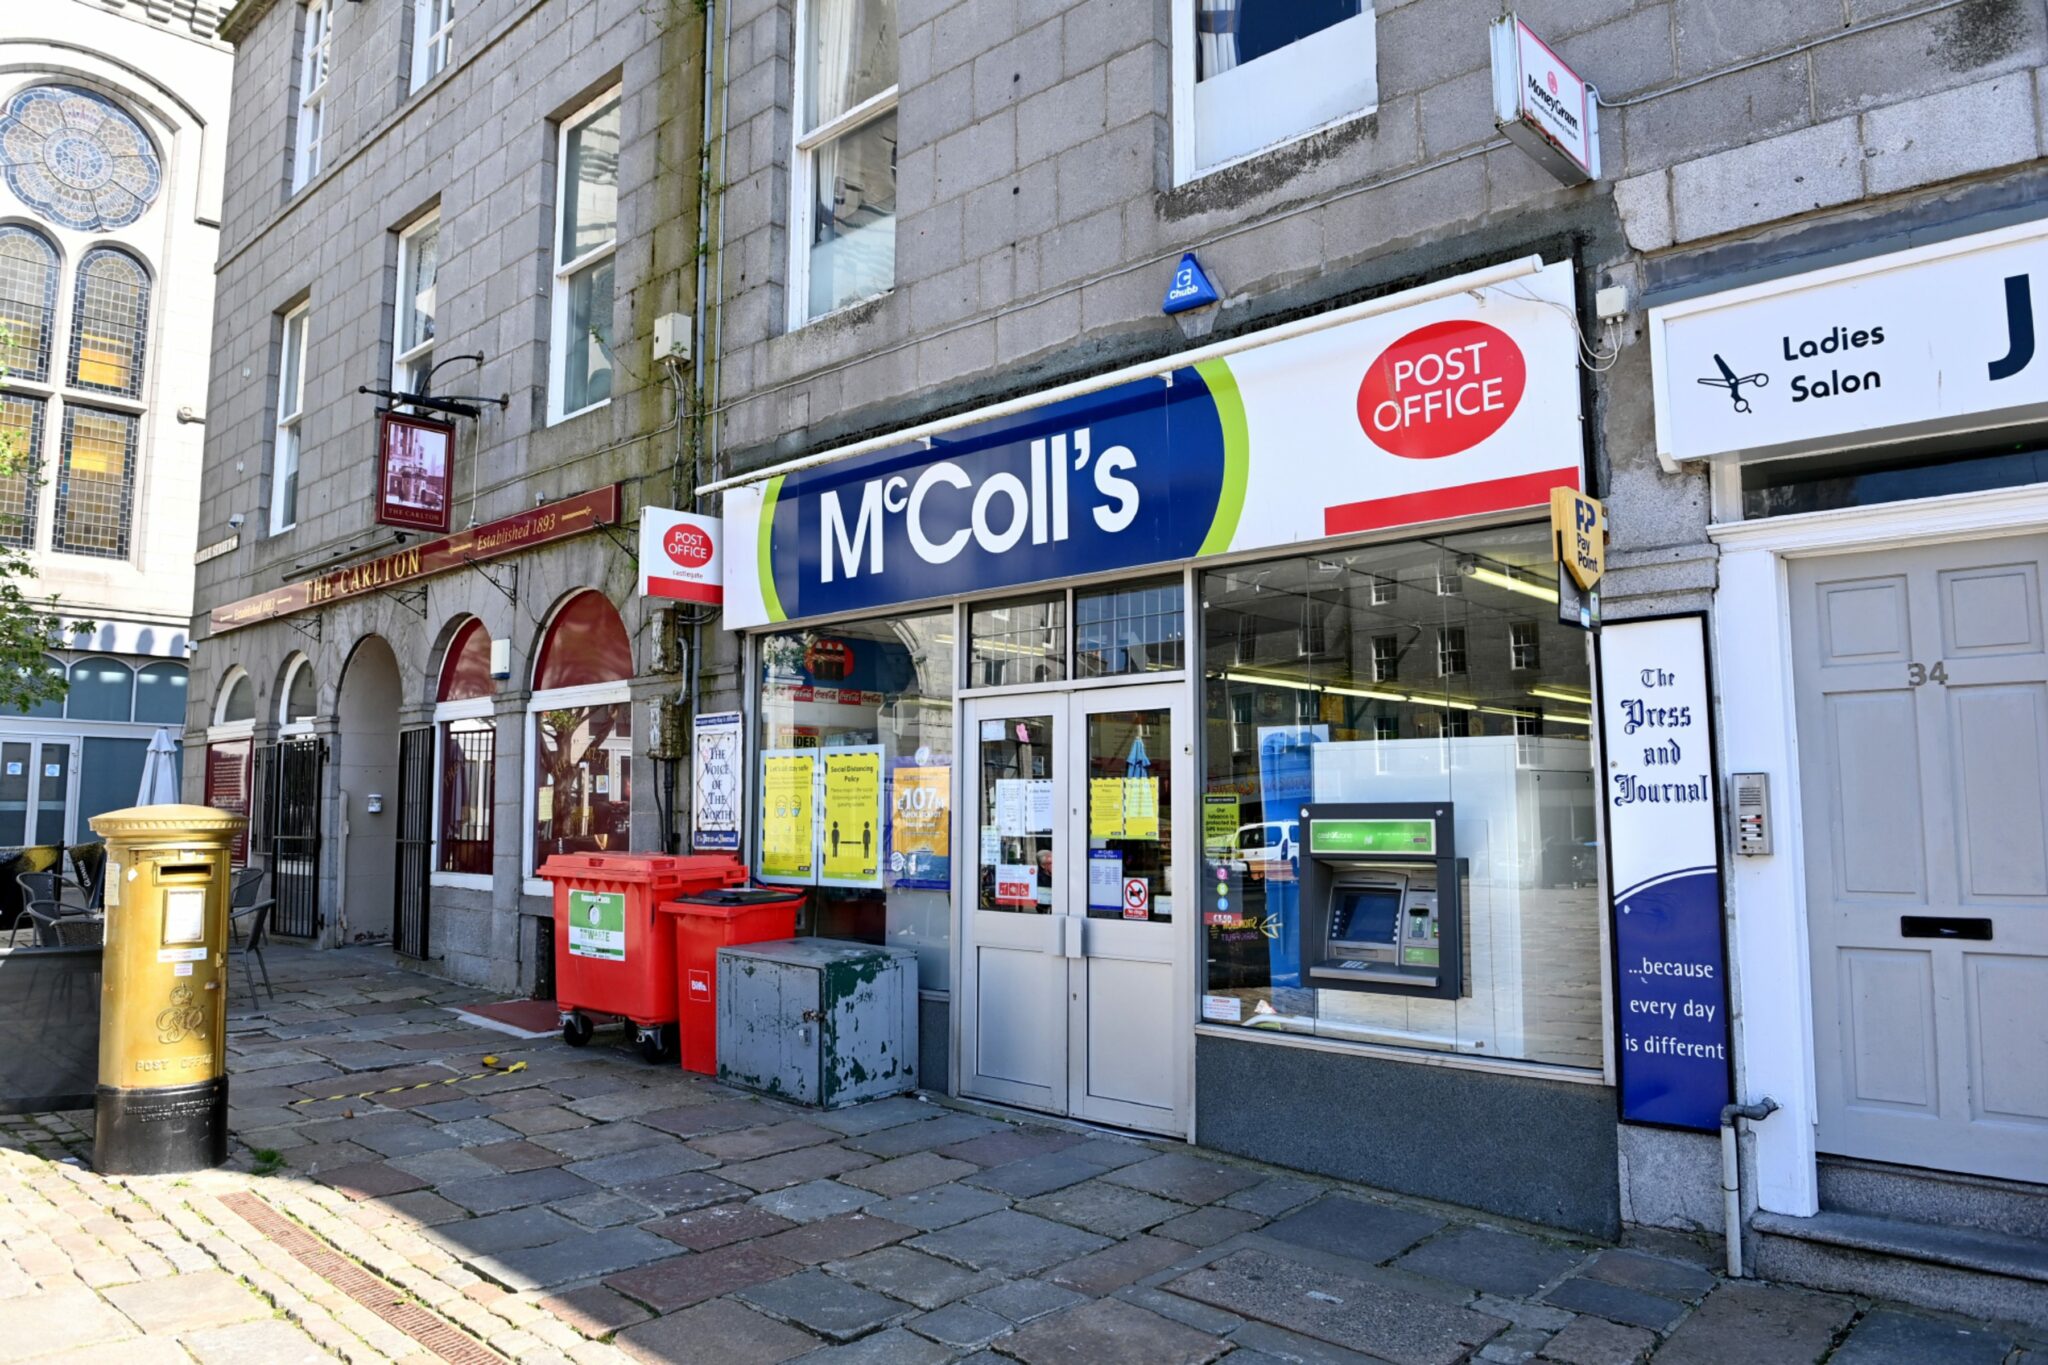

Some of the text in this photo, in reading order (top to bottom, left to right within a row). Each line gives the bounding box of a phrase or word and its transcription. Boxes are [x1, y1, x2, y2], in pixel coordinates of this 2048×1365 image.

[1528, 74, 1578, 130] MoneyGram
[1169, 284, 1199, 300] Chubb
[1987, 273, 2036, 382] J
[1782, 325, 1885, 362] Ladies
[1394, 341, 1488, 392] POST
[1790, 370, 1882, 403] Salon
[1373, 377, 1504, 432] OFFICE
[388, 507, 440, 521] THE CARLTON
[820, 427, 1140, 584] McColl's
[476, 513, 556, 551] Established 1893
[675, 531, 703, 545] POST
[1577, 532, 1591, 556] Pay
[668, 543, 707, 559] OFFICE
[1577, 551, 1598, 574] Point
[304, 547, 421, 605] THE CARLTON
[1640, 668, 1675, 688] The
[1906, 662, 1948, 687] 34
[1620, 698, 1692, 735] Press
[709, 747, 725, 760] THE
[1643, 738, 1682, 767] and
[704, 763, 730, 775] VOICE
[830, 765, 874, 774] Social Distancing
[712, 780, 722, 790] OF
[1614, 774, 1709, 807] Journal
[708, 792, 726, 805] THE
[702, 807, 733, 821] NORTH
[1629, 999, 1716, 1023] every day
[1624, 1033, 1725, 1060] is different
[135, 1059, 169, 1072] POST
